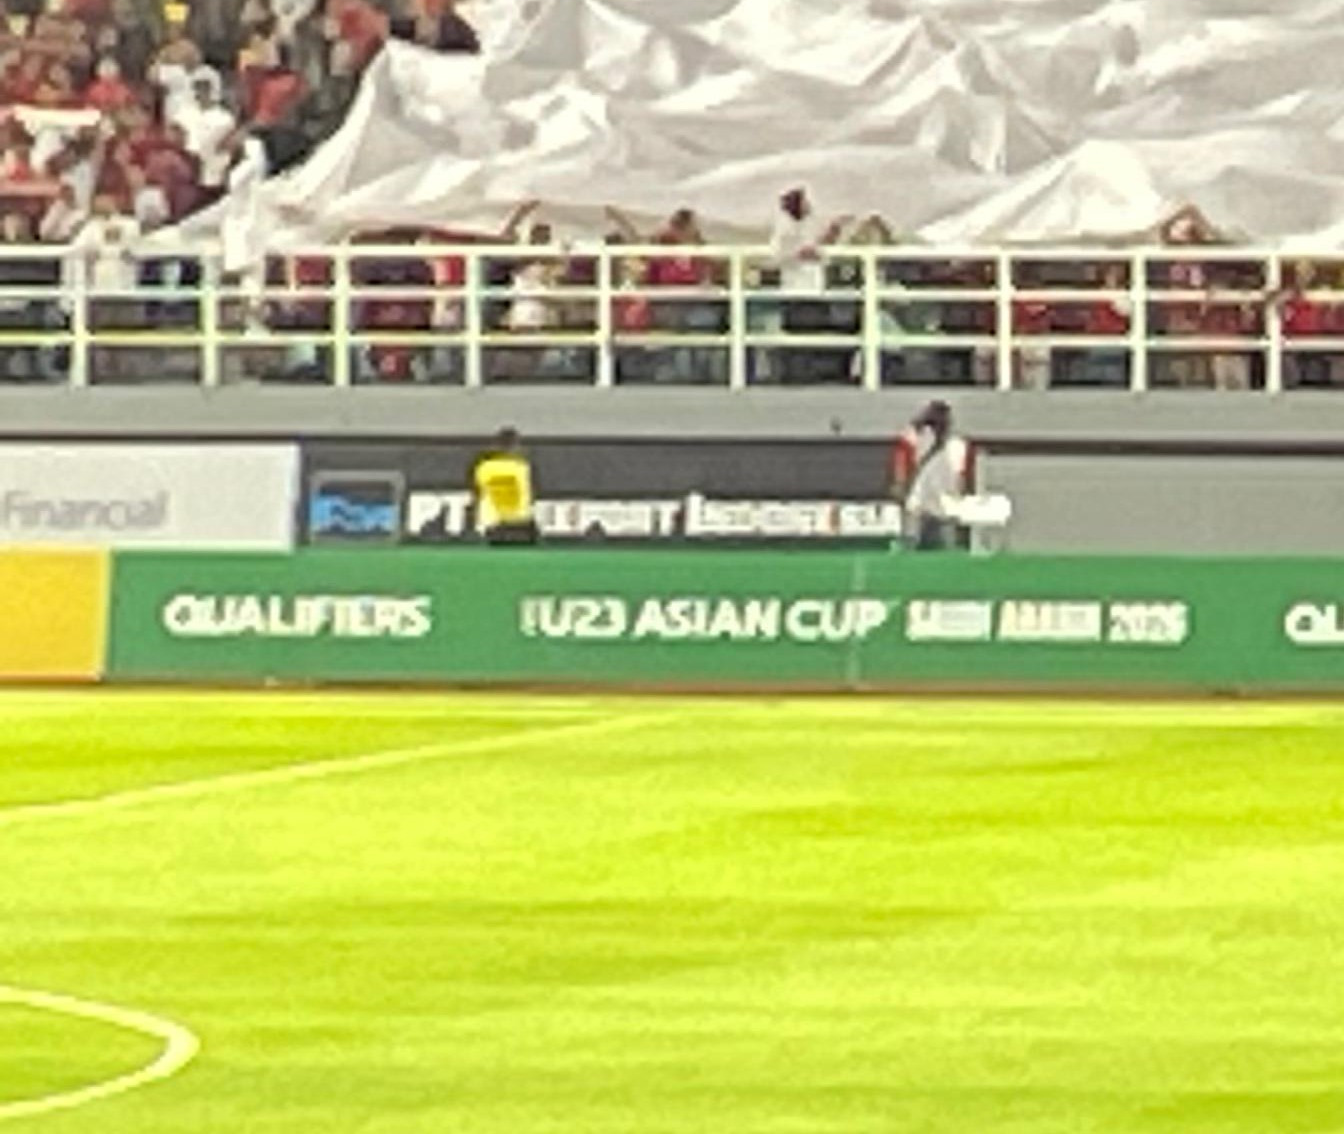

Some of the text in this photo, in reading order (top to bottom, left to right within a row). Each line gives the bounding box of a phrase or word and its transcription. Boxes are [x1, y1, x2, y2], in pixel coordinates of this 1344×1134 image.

[3, 489, 170, 530] Financial
[408, 491, 473, 535] PT
[164, 594, 432, 637] QUALIFIERS
[634, 598, 780, 639] ASIAN
[785, 600, 888, 639] CUP
